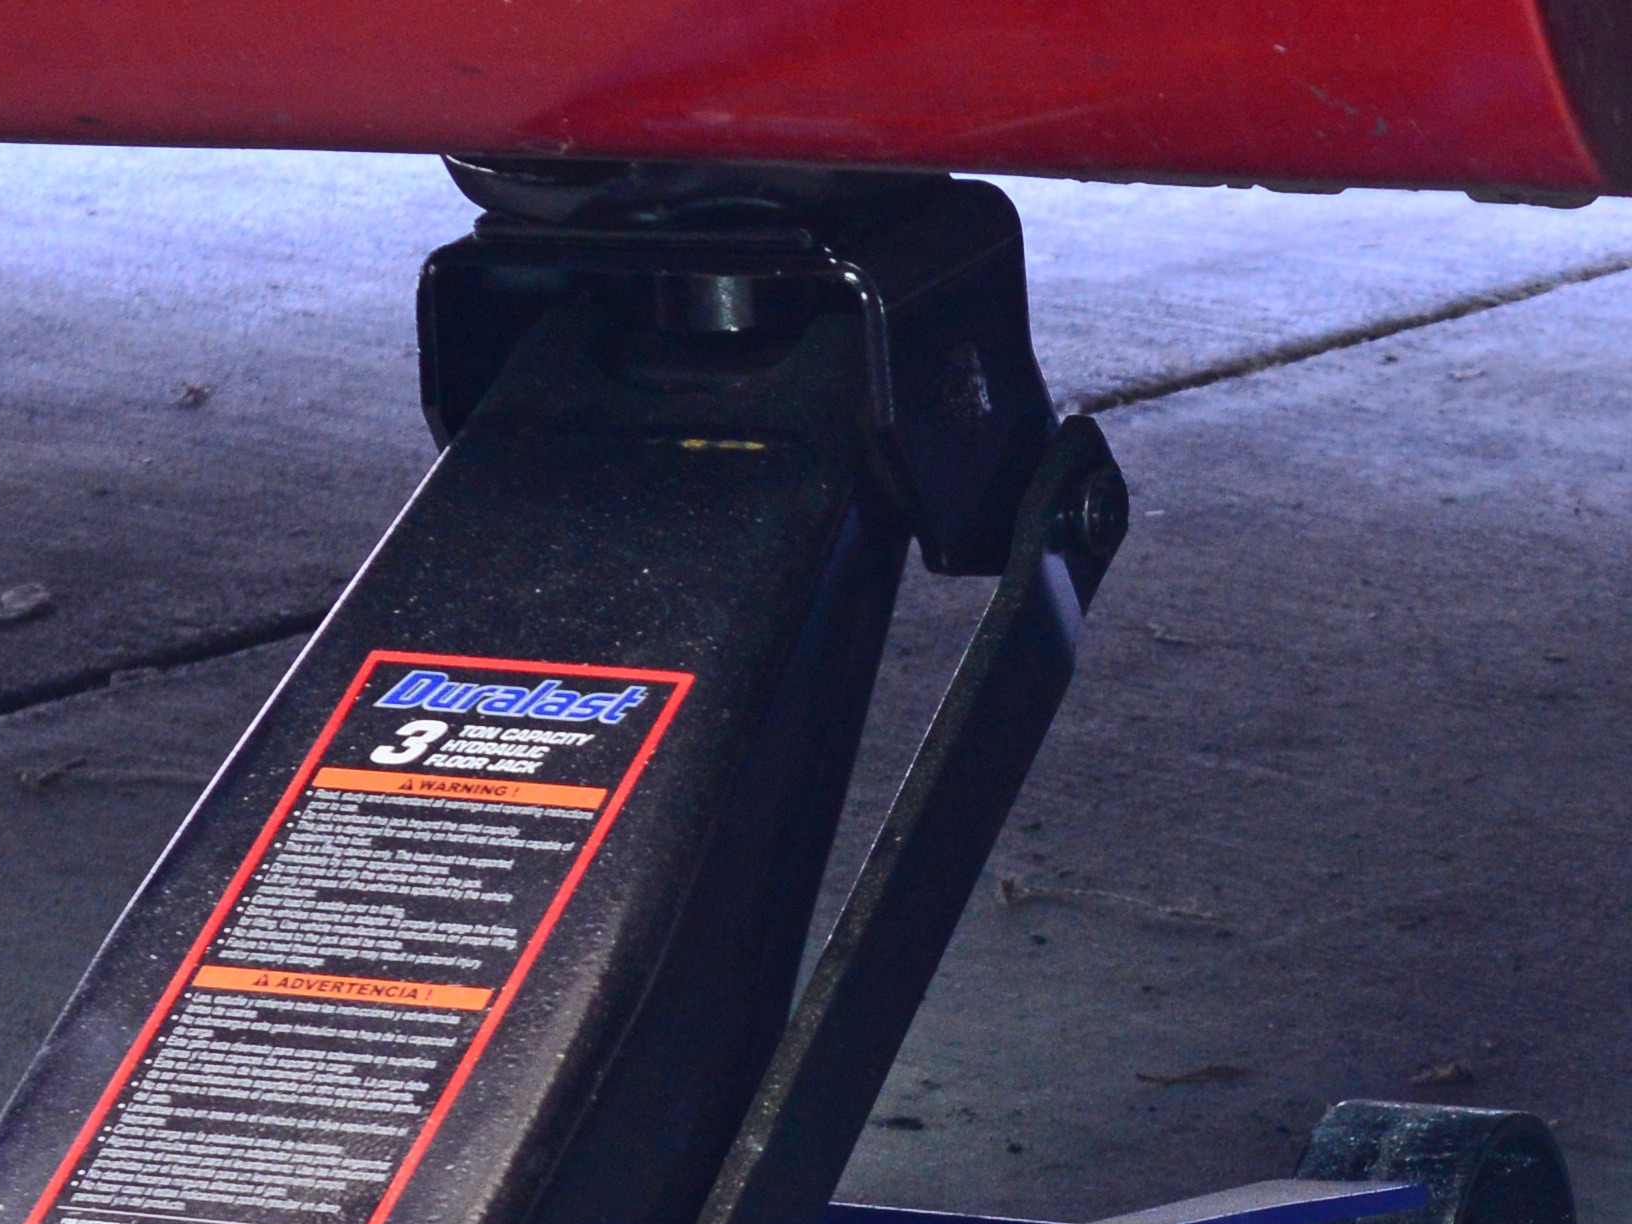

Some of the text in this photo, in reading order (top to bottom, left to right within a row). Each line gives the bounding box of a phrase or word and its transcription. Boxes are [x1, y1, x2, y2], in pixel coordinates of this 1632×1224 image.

[373, 670, 647, 724] Duralast
[369, 720, 595, 765] 3 TON CAPACITY
[440, 739, 550, 759] HYDRAULIC
[423, 753, 543, 774] FLOOR JACK
[419, 780, 508, 797] WARNING
[276, 977, 419, 999] ADVERTENCIA
